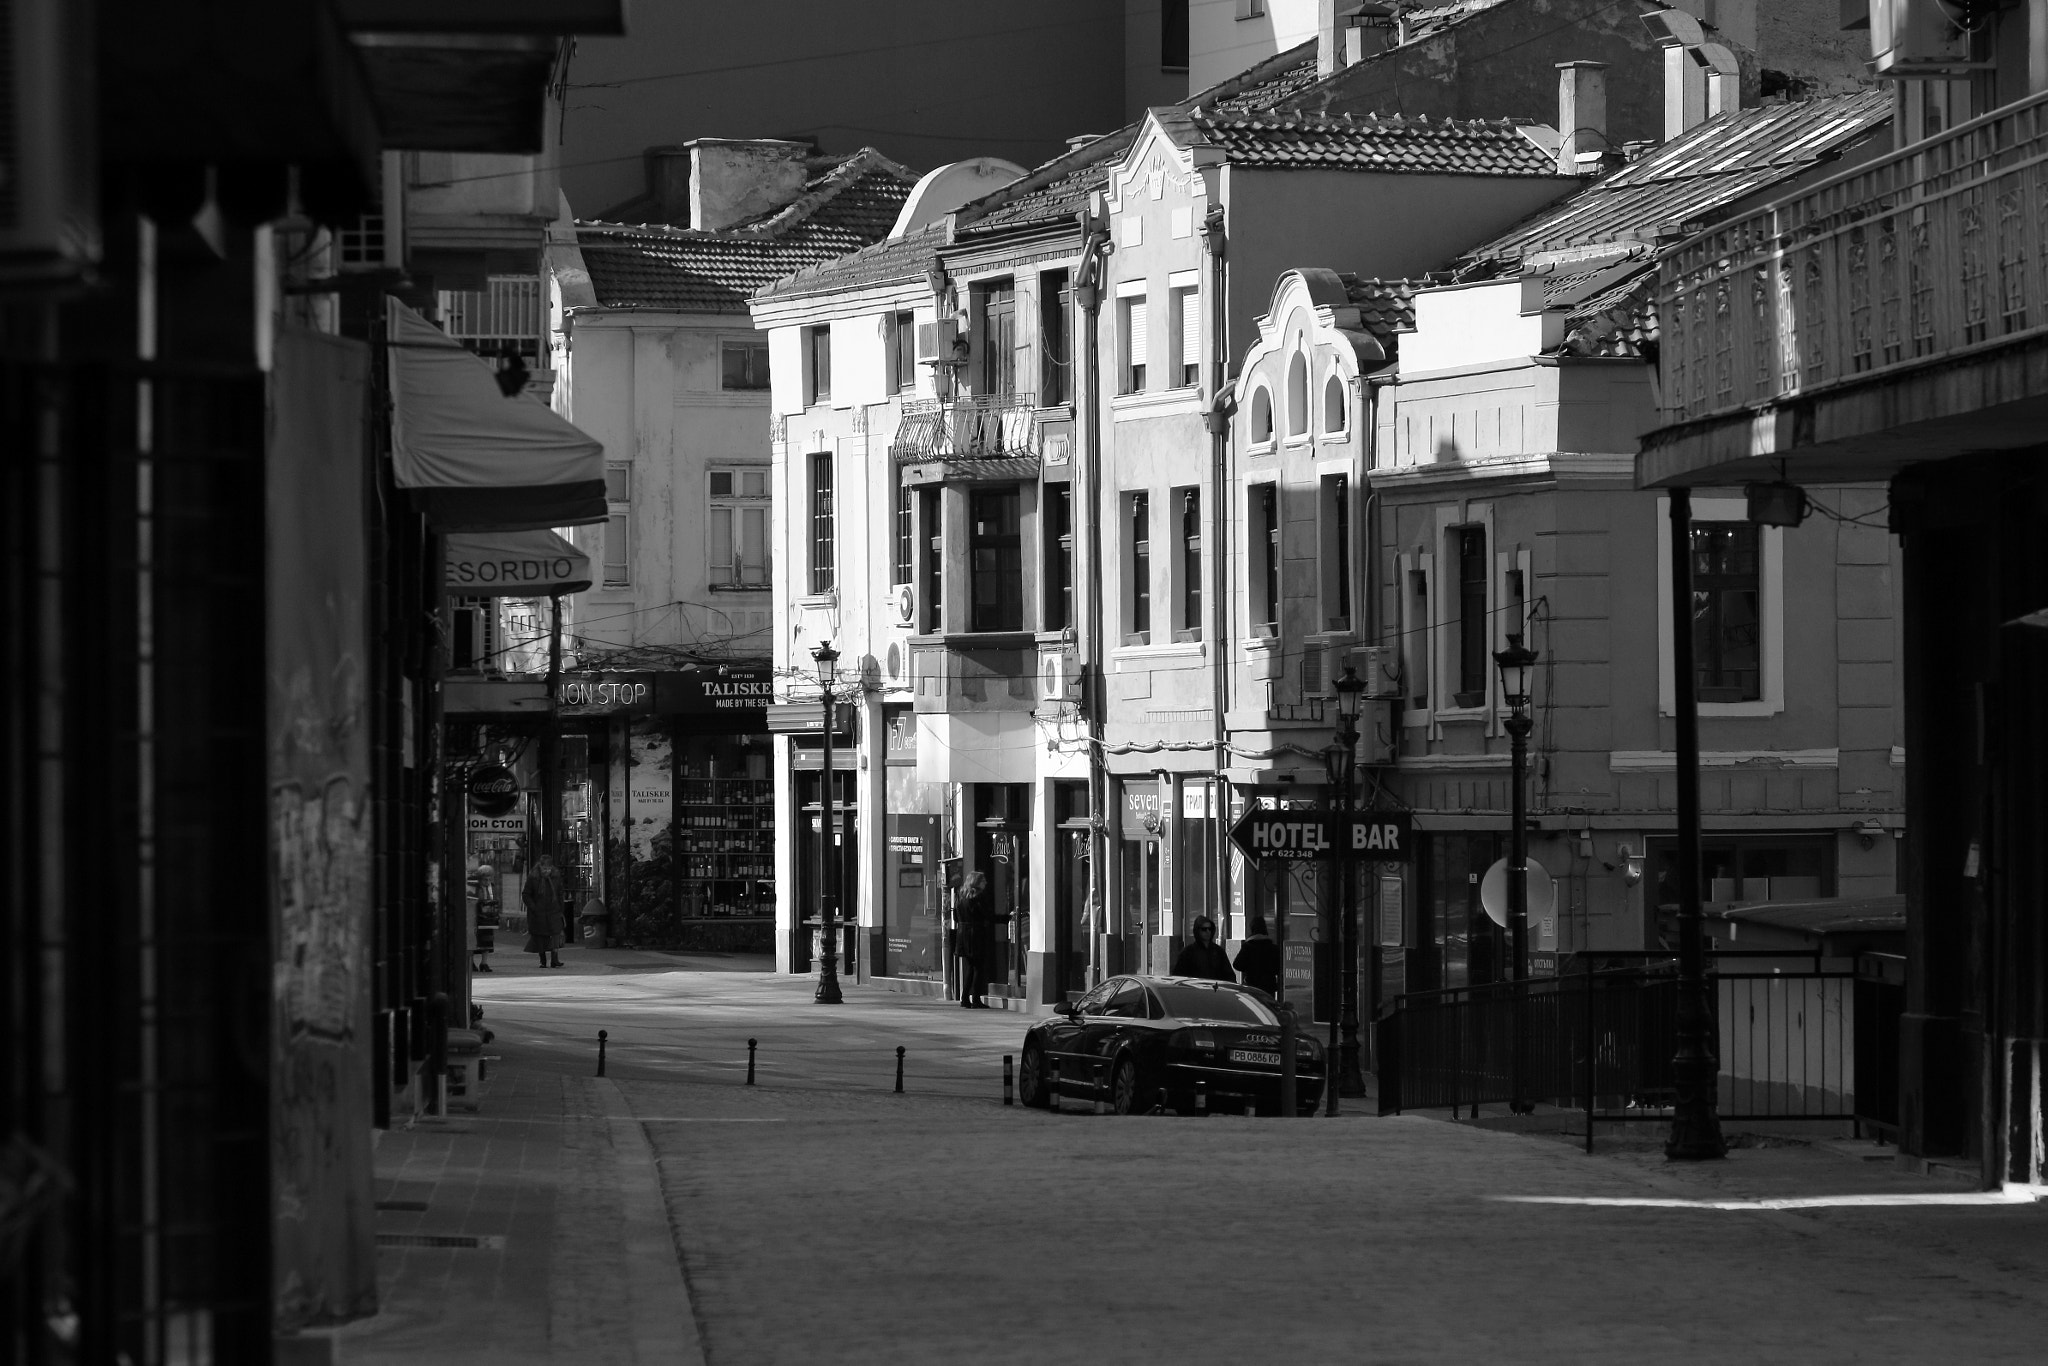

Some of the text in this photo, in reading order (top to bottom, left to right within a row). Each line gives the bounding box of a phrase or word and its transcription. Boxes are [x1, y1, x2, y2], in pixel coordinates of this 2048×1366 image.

[598, 683, 646, 705] STOP
[702, 681, 773, 696] TALISKE
[716, 699, 734, 708] MADE
[735, 699, 743, 708] BY
[745, 699, 756, 708] THE
[1129, 794, 1158, 811] seven
[492, 820, 523, 828] СТОП
[1252, 821, 1400, 850] HOTEL BAR
[1277, 850, 1313, 858] 622 348
[1234, 1052, 1246, 1061] PB
[1268, 1054, 1280, 1064] KP
